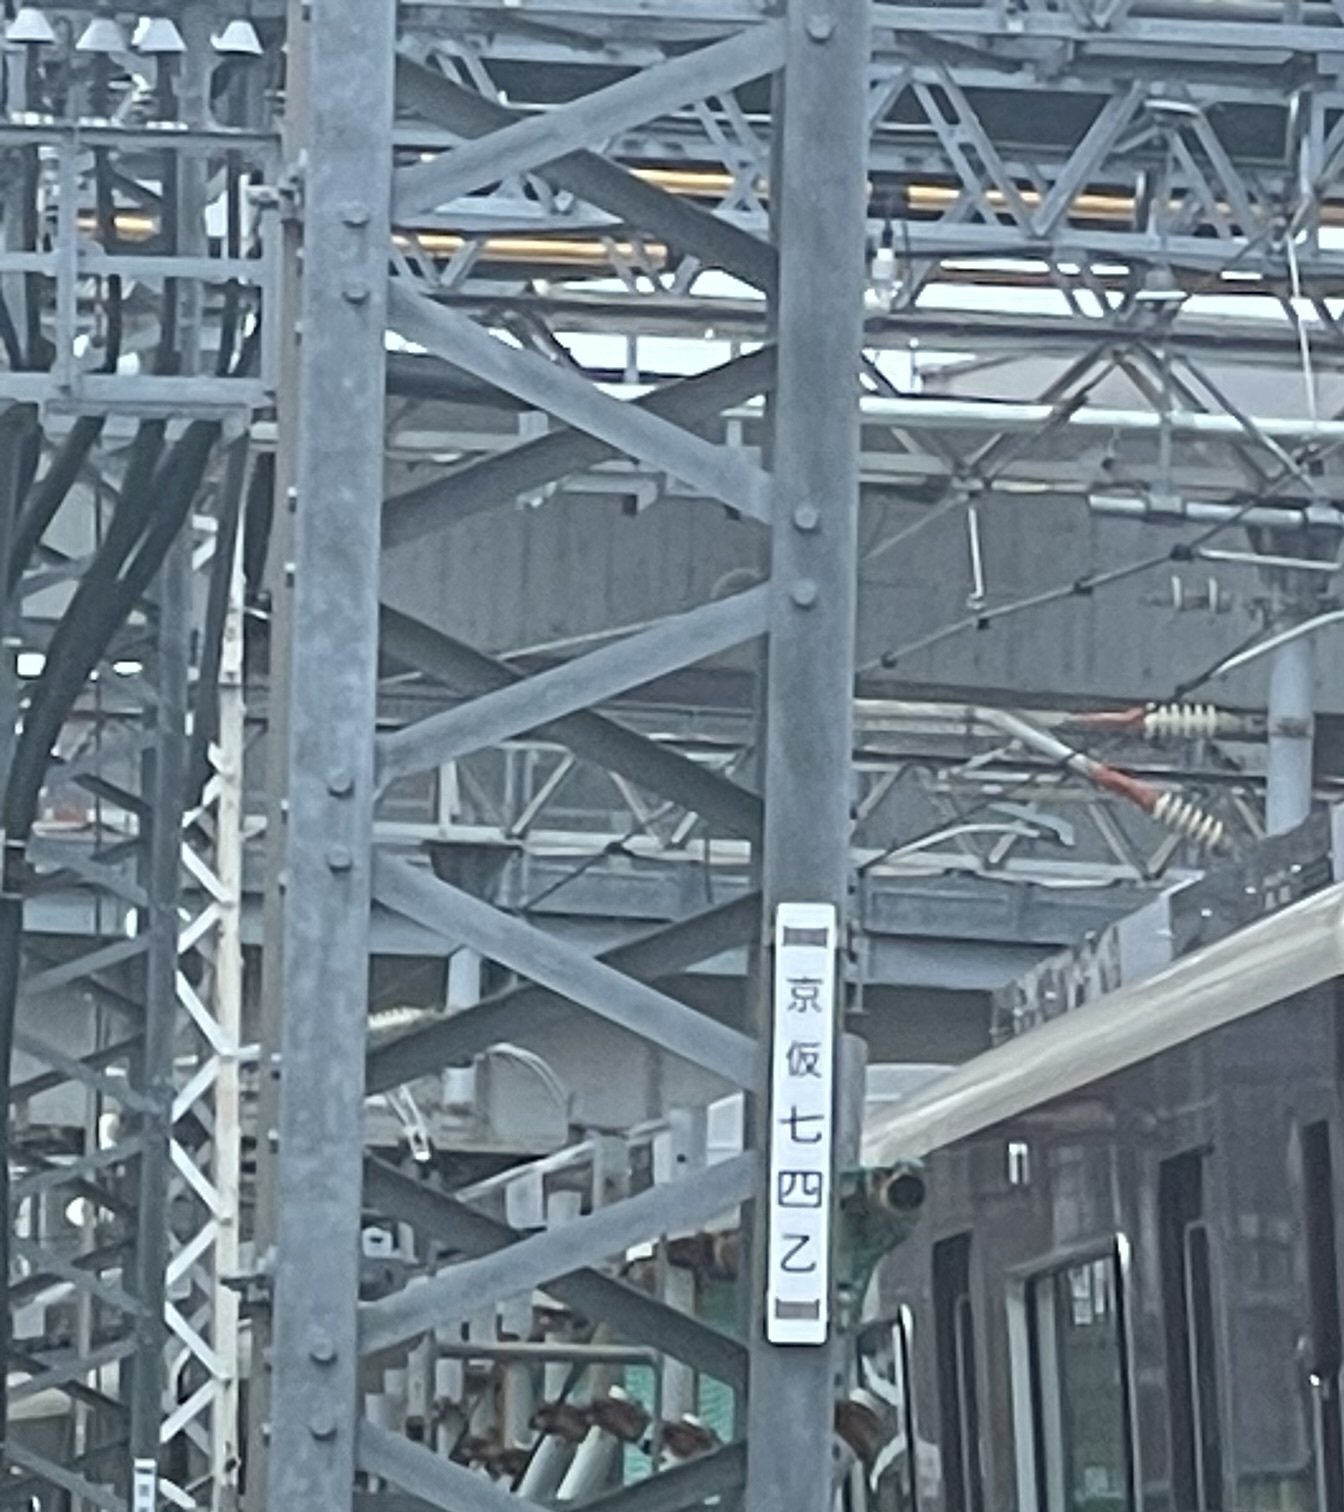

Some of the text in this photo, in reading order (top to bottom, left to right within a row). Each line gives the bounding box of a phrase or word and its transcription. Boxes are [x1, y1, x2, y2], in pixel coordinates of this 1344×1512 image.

[777, 976, 826, 1274] 京仮七四乙
